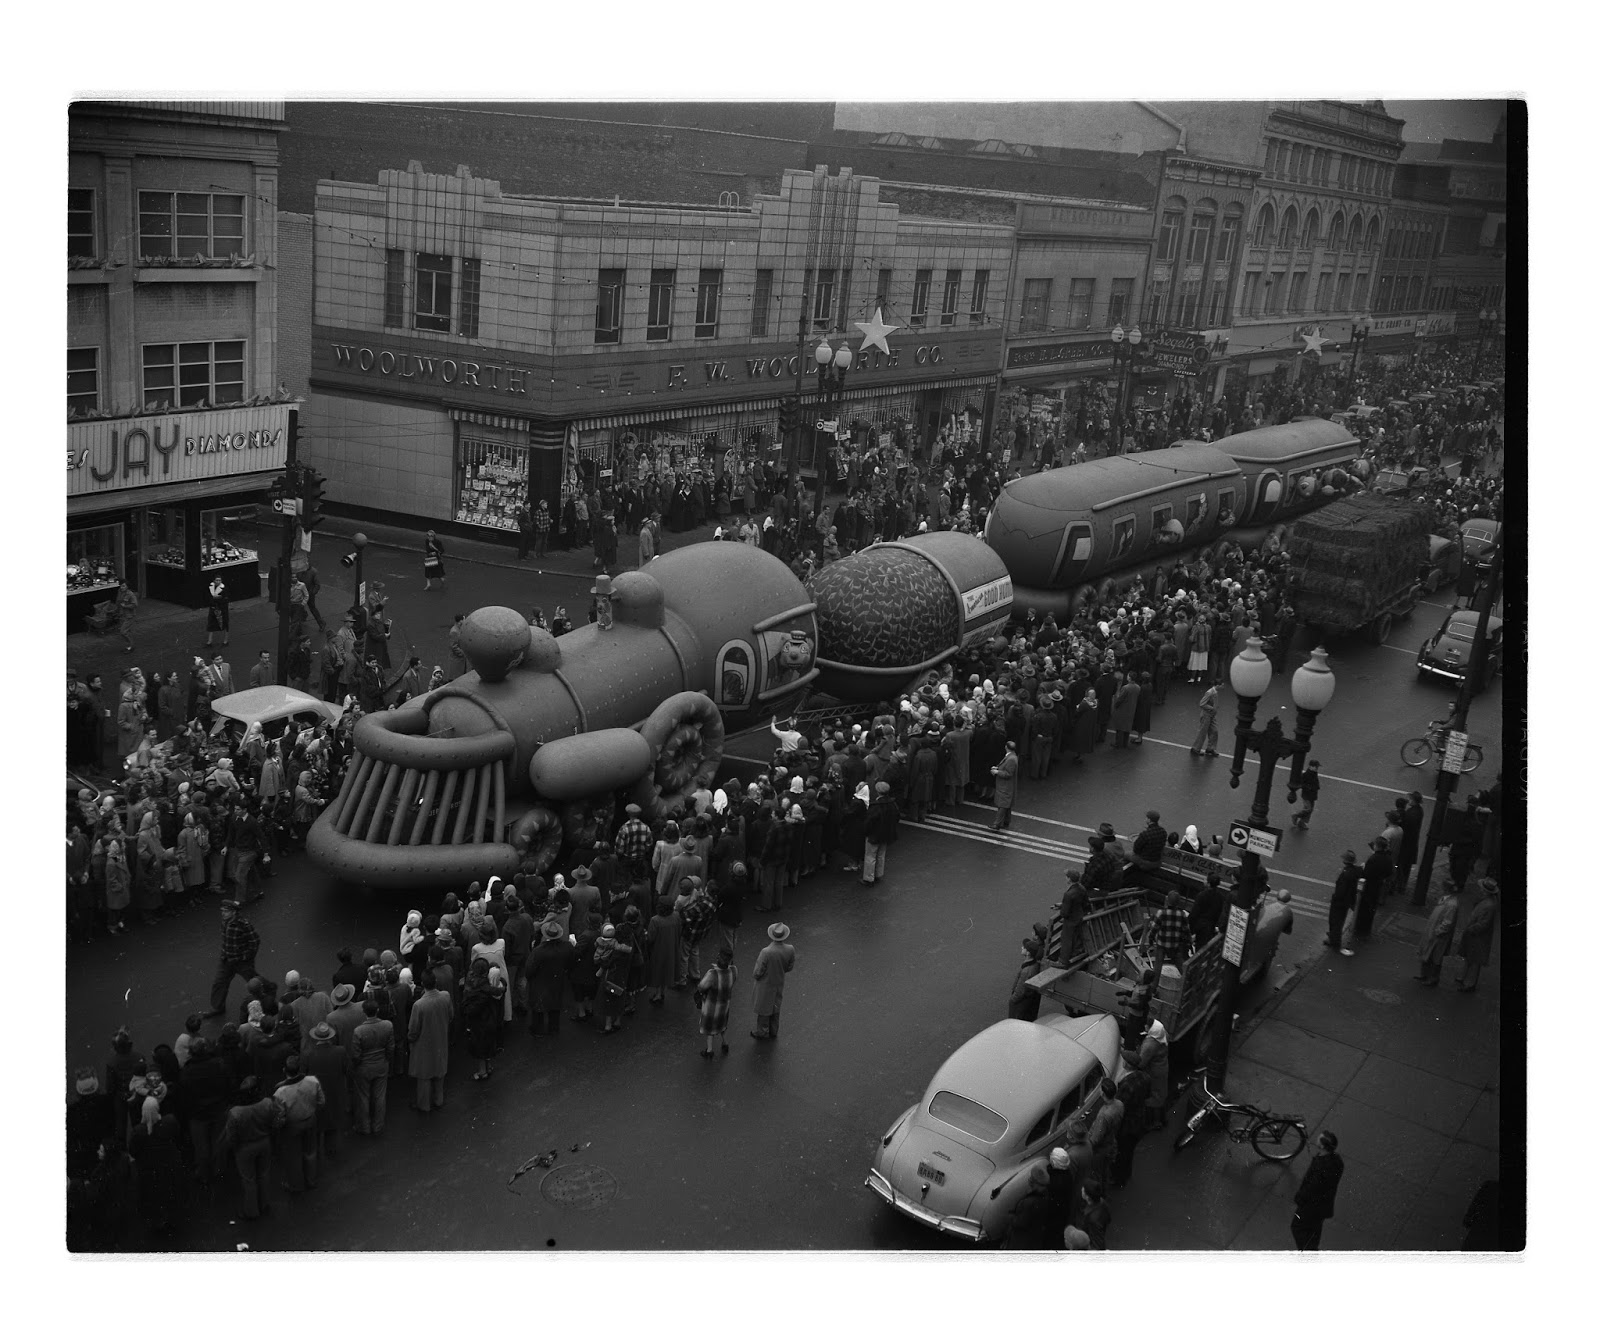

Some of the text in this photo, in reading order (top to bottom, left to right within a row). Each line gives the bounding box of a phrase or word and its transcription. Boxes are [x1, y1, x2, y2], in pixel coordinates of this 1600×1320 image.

[1153, 331, 1195, 349] Segel's
[1154, 353, 1193, 365] JEWELERS
[331, 343, 527, 393] WOOLWORTH
[669, 345, 944, 387] F. W. WOOLRTH CO.
[90, 424, 180, 482] JAY
[185, 428, 283, 456] DIAMONDS
